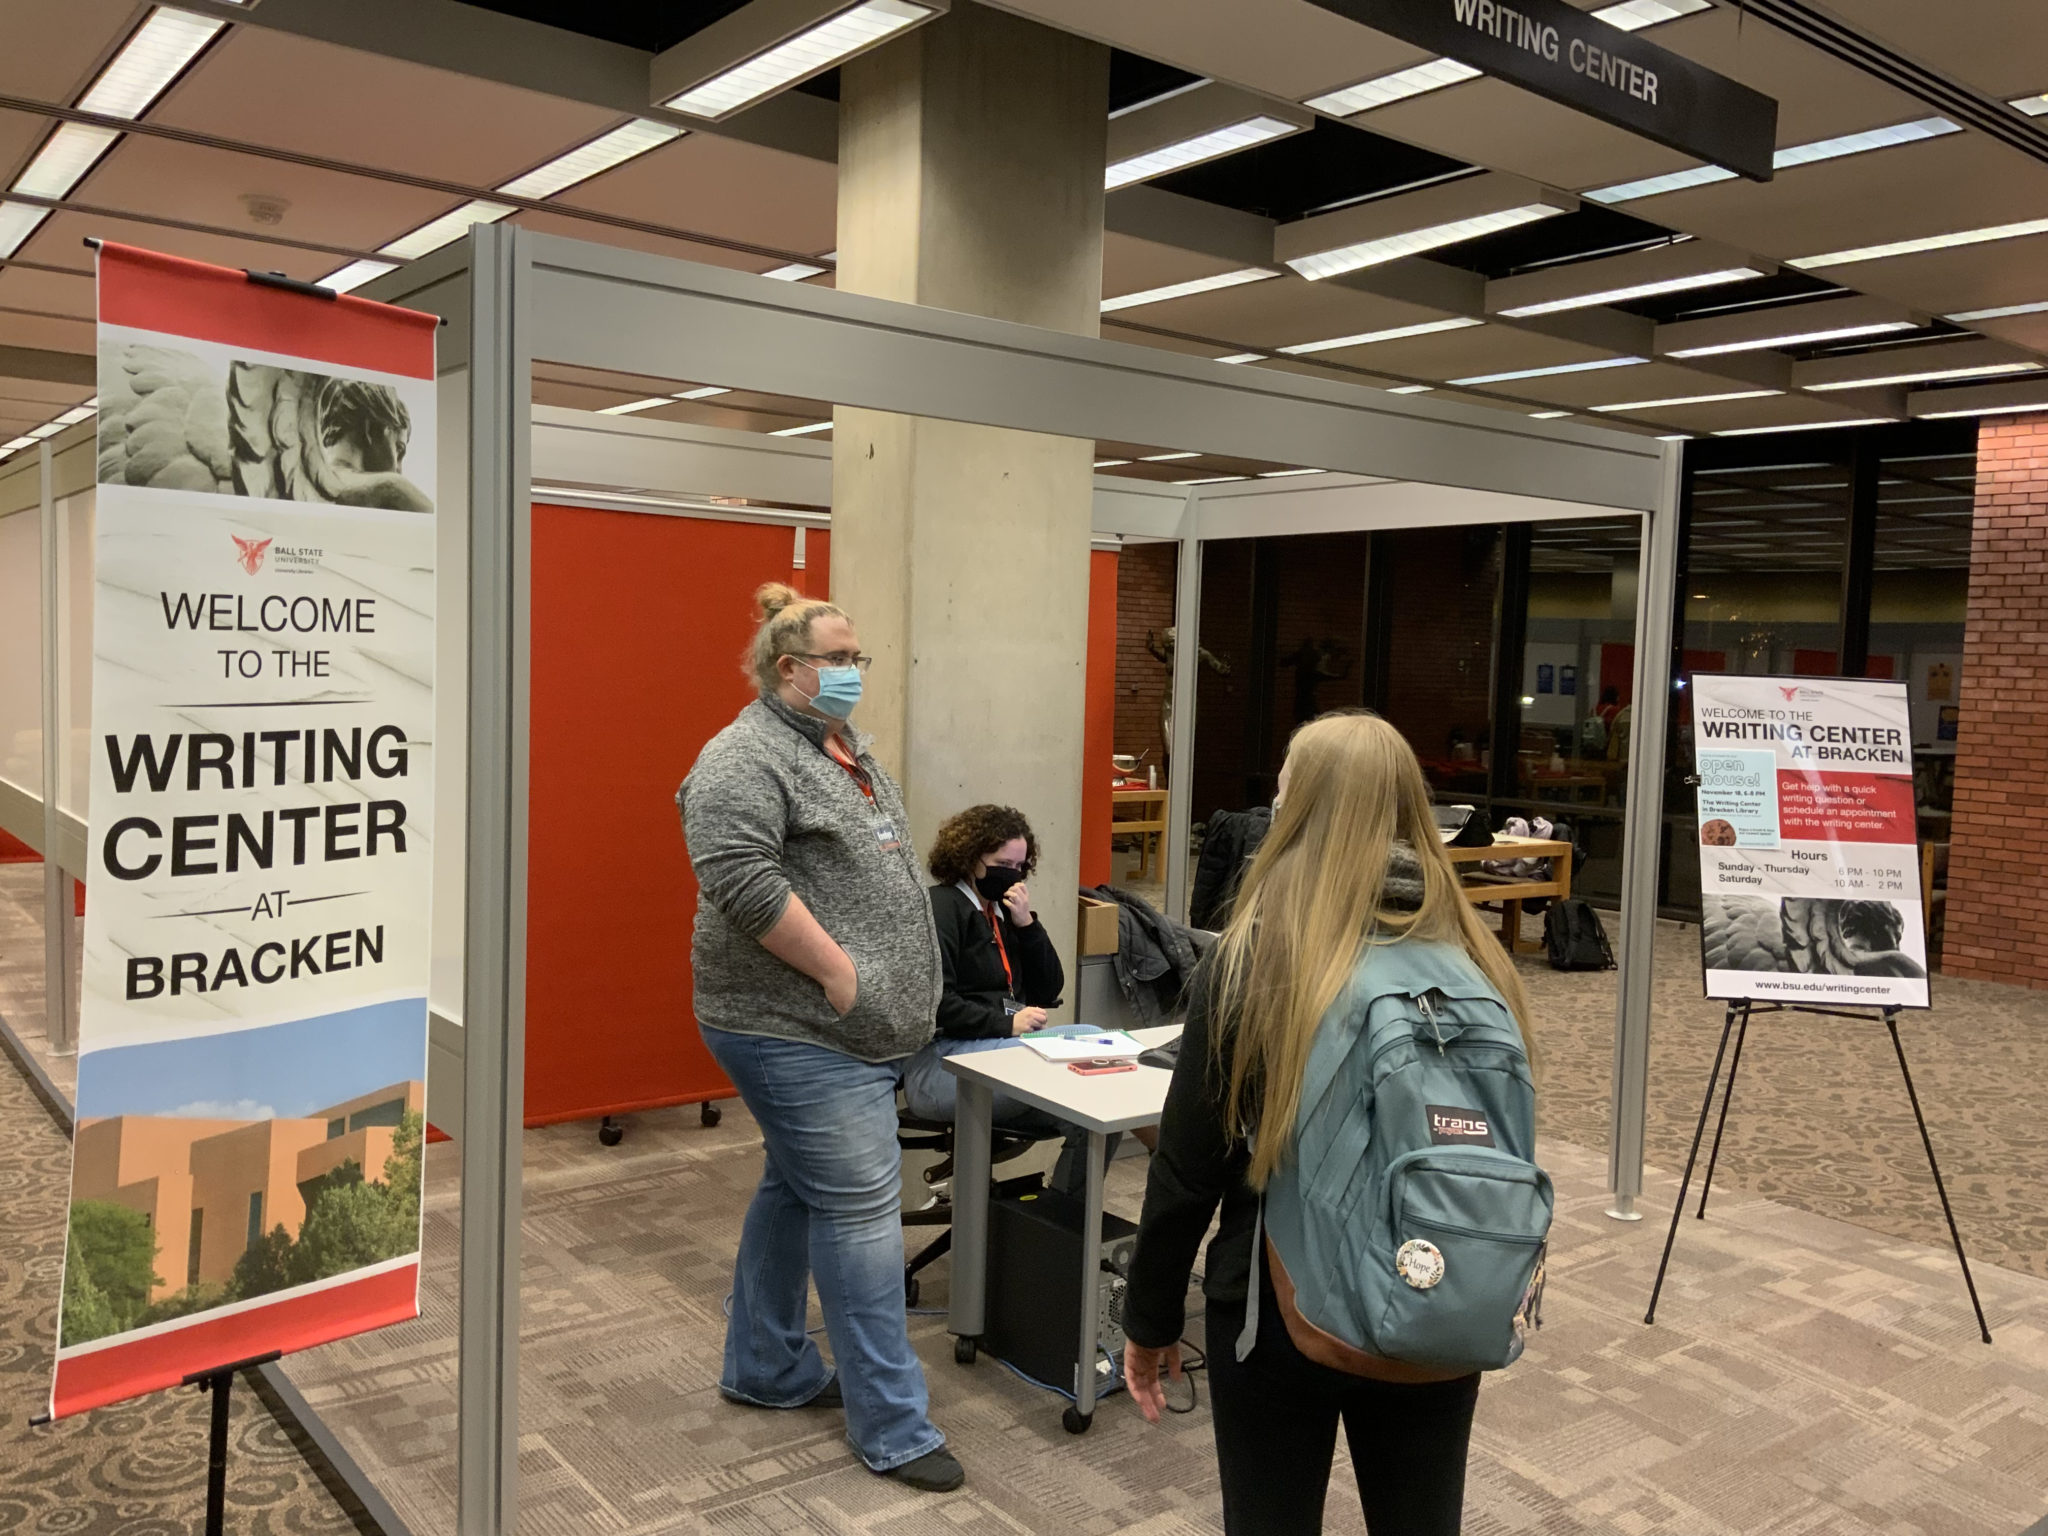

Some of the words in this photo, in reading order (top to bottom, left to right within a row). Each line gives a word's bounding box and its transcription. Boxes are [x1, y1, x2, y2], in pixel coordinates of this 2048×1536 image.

[1454, 0, 1559, 62] WRITING
[1568, 38, 1658, 105] CENTER
[275, 546, 296, 555] BALL
[298, 548, 323, 557] STATE
[275, 557, 319, 565] UNIVERSITY
[160, 591, 376, 633] WELCOME
[217, 650, 262, 678] TO
[272, 650, 330, 678] THE
[1701, 708, 1765, 720] WELCOME
[1769, 710, 1785, 721] TO
[1789, 711, 1813, 721] THE
[1702, 721, 1803, 741] WRITING
[1810, 725, 1902, 746] CENTER
[105, 725, 408, 793] WRITING
[1791, 745, 1812, 759] AT
[1818, 746, 1903, 763] BRACKEN
[1700, 759, 1744, 774] open
[1701, 770, 1760, 787] house!
[1781, 782, 1799, 791] Get
[1801, 782, 1820, 793] help
[1822, 783, 1841, 793] with
[1844, 785, 1850, 793] a
[1852, 785, 1877, 795] quick
[1782, 794, 1813, 805] writing
[1815, 795, 1854, 805] question
[1856, 797, 1866, 805] or
[1783, 806, 1825, 815] schedule
[1826, 808, 1838, 816] an
[1840, 808, 1897, 818] appointment
[1784, 817, 1802, 826] with
[1805, 818, 1819, 827] the
[1822, 818, 1852, 829] writing
[1854, 820, 1884, 829] center.
[103, 799, 408, 881] CENTER
[1791, 850, 1828, 861] Hours
[1718, 862, 1754, 873] Sunday
[1764, 863, 1810, 876] Thursday
[1847, 867, 1863, 876] PM
[1873, 868, 1884, 877] 10
[1886, 869, 1902, 878] PM
[1718, 873, 1762, 886] Saturday
[1834, 879, 1846, 888] 10
[1848, 879, 1864, 888] AM
[1878, 880, 1884, 890] 2
[1887, 881, 1903, 890] PM
[251, 890, 290, 921] AT
[126, 925, 384, 1000] BRACKEN
[1755, 981, 1890, 995] www.bsu.edu/writingcenter
[1434, 1113, 1488, 1135] trans
[1409, 1258, 1430, 1274] Hope
